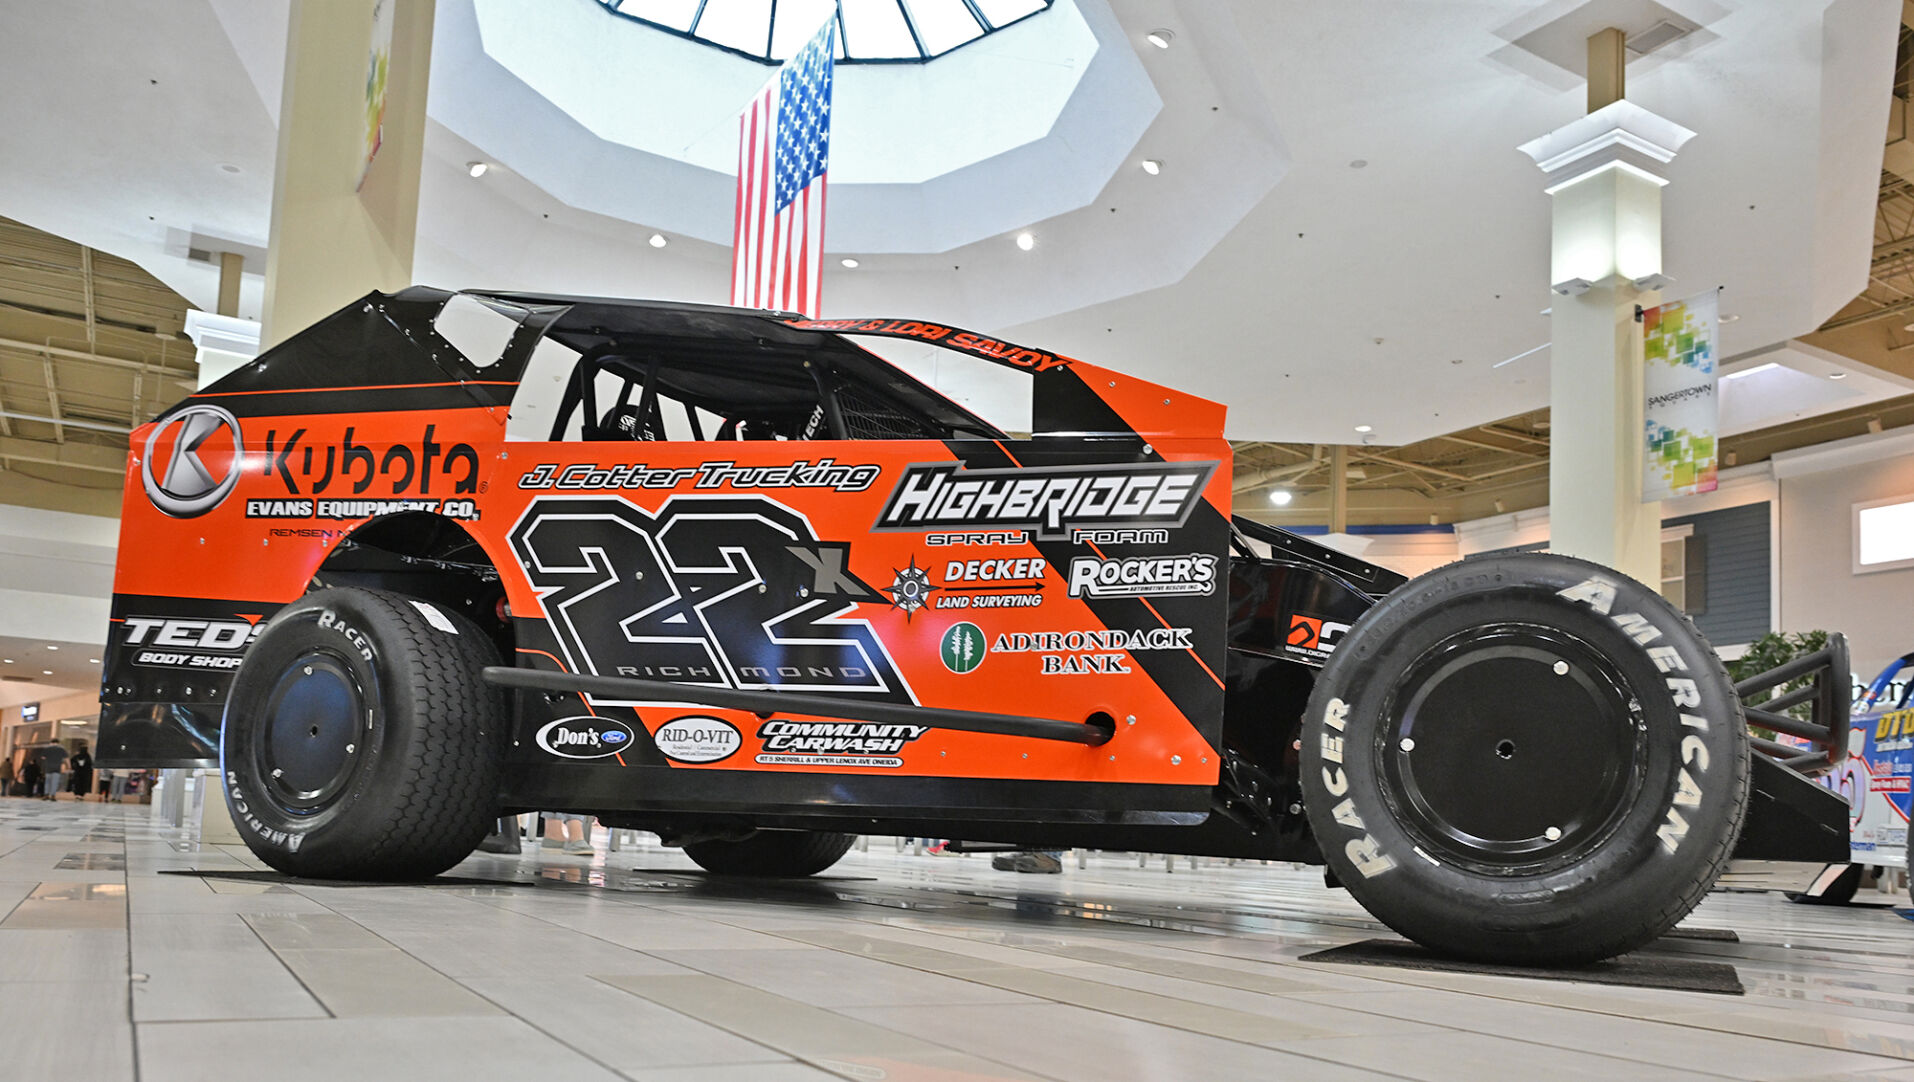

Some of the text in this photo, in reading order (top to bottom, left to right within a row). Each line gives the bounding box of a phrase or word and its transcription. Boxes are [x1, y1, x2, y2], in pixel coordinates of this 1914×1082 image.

[880, 320, 952, 341] LORI
[946, 331, 1074, 373] SAVOY
[1648, 384, 1712, 406] SANGERTOWN
[263, 424, 480, 494] Kubota
[694, 459, 881, 492] Trucking
[246, 500, 314, 518] EVANS
[886, 472, 1199, 528] HIGHBRIDGE
[269, 528, 334, 538] REMSEN
[926, 529, 1169, 546] SPRAY FOAM
[944, 558, 1047, 582] DECKER
[1069, 556, 1214, 597] ROCKER'S
[935, 594, 1042, 610] LAND SURVEYING
[317, 609, 373, 662] RACER
[991, 627, 1193, 652] ADIRONDACK
[138, 652, 244, 669] BODY SHOP
[1555, 576, 1710, 855] AMERICAN
[557, 727, 600, 746] Don's
[662, 728, 734, 745] RID-O-VIT
[762, 721, 928, 738] COMMUNITY
[767, 735, 903, 752] CARWASH
[1320, 697, 1397, 879] RACER
[227, 771, 306, 853] AMERICAN
